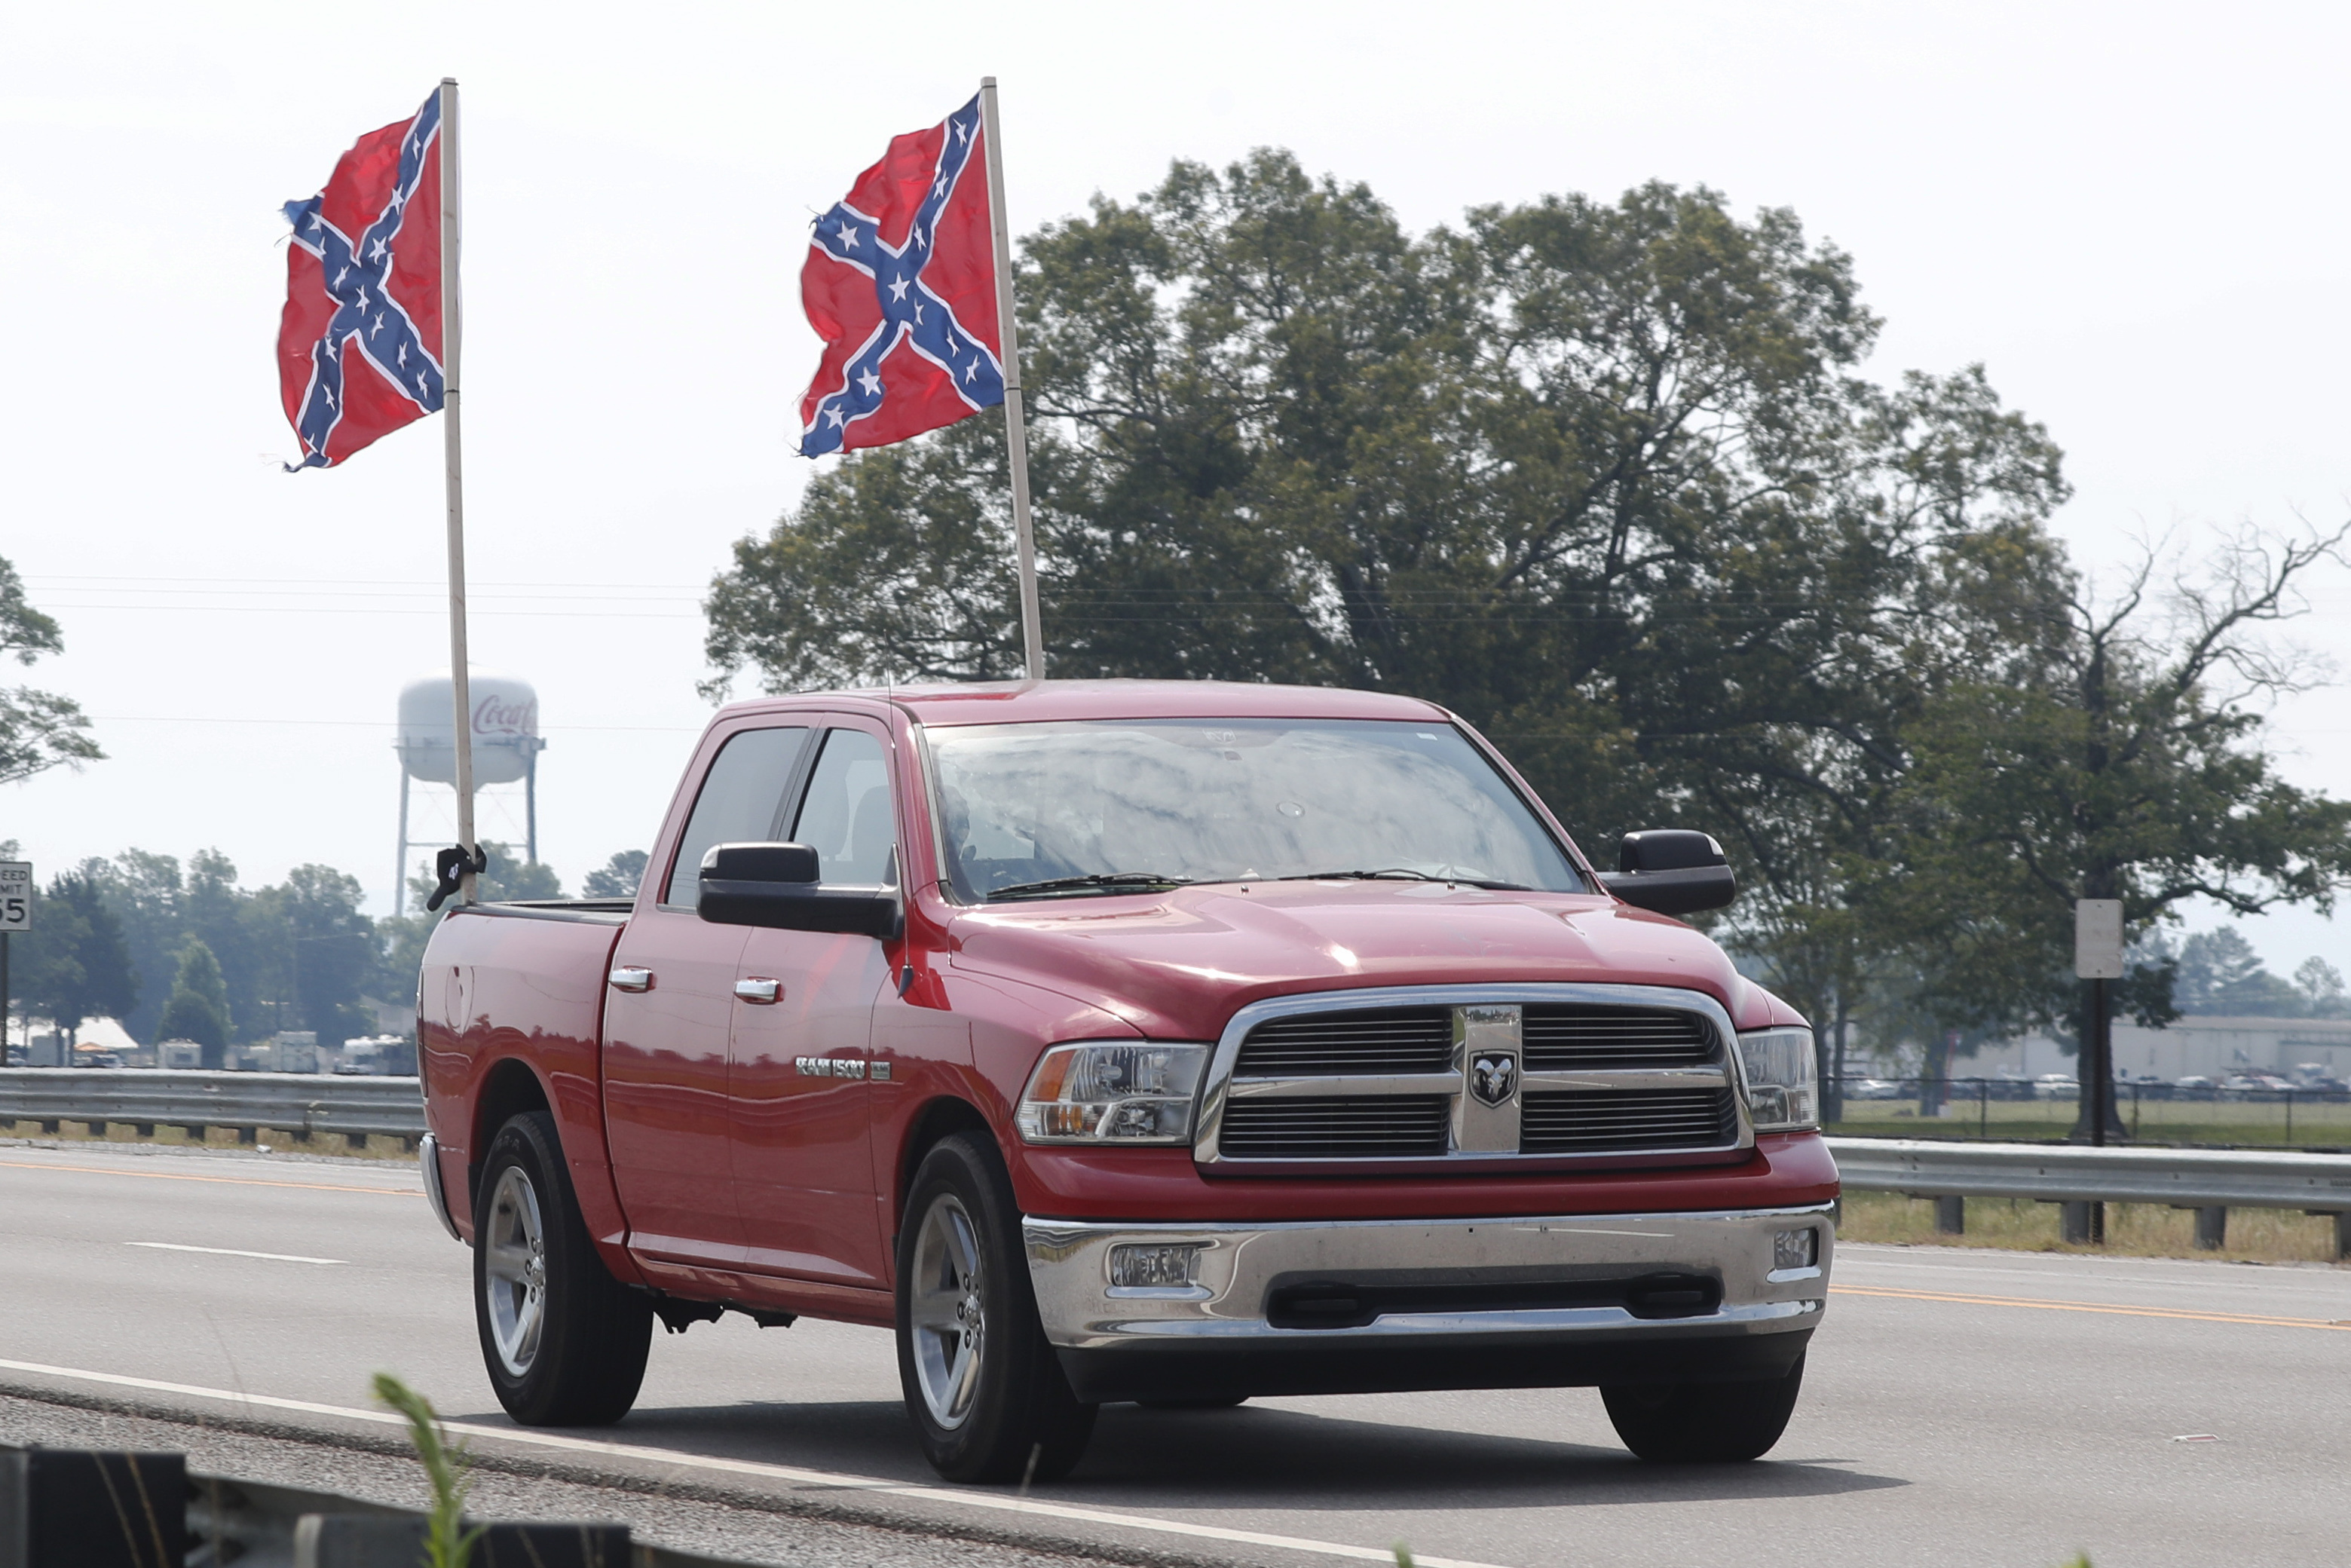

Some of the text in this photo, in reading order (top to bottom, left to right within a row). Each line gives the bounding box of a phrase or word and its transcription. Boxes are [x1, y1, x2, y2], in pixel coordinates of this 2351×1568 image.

[0, 870, 28, 880] EED
[0, 884, 23, 895] MIT
[0, 898, 25, 923] 5
[795, 1057, 831, 1076] RAM
[832, 1059, 865, 1080] 1500
